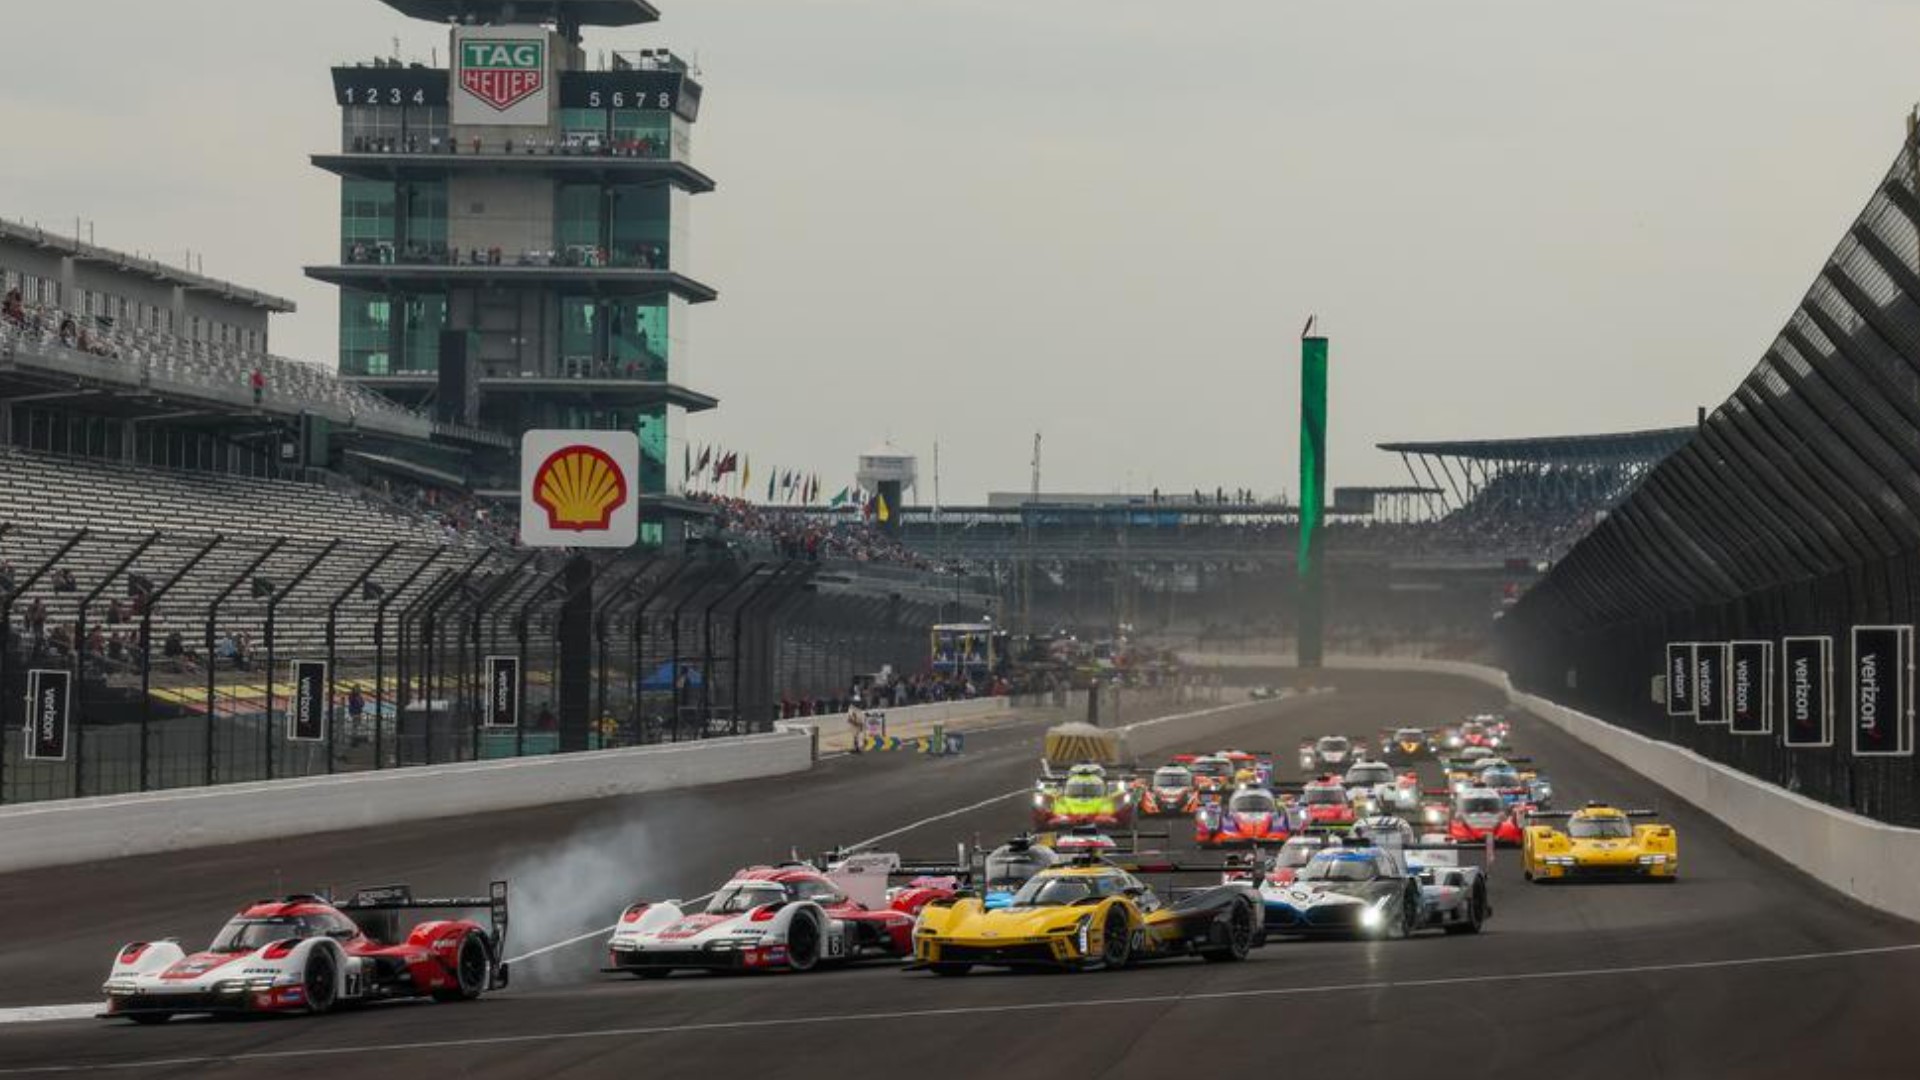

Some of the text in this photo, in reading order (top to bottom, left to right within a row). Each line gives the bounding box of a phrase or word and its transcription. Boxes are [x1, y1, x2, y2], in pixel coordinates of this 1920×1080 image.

[468, 45, 534, 66] TAG
[345, 88, 425, 104] 1 2 3 4
[465, 71, 537, 103] HEUER
[589, 92, 670, 108] 5 6 7 8
[1700, 659, 1711, 706] verizon
[1736, 660, 1751, 712] verizon
[1795, 657, 1812, 720] verizon
[1860, 653, 1880, 729] verizon
[42, 687, 57, 740] verizon
[832, 935, 840, 955] 6
[350, 974, 358, 992] 7
